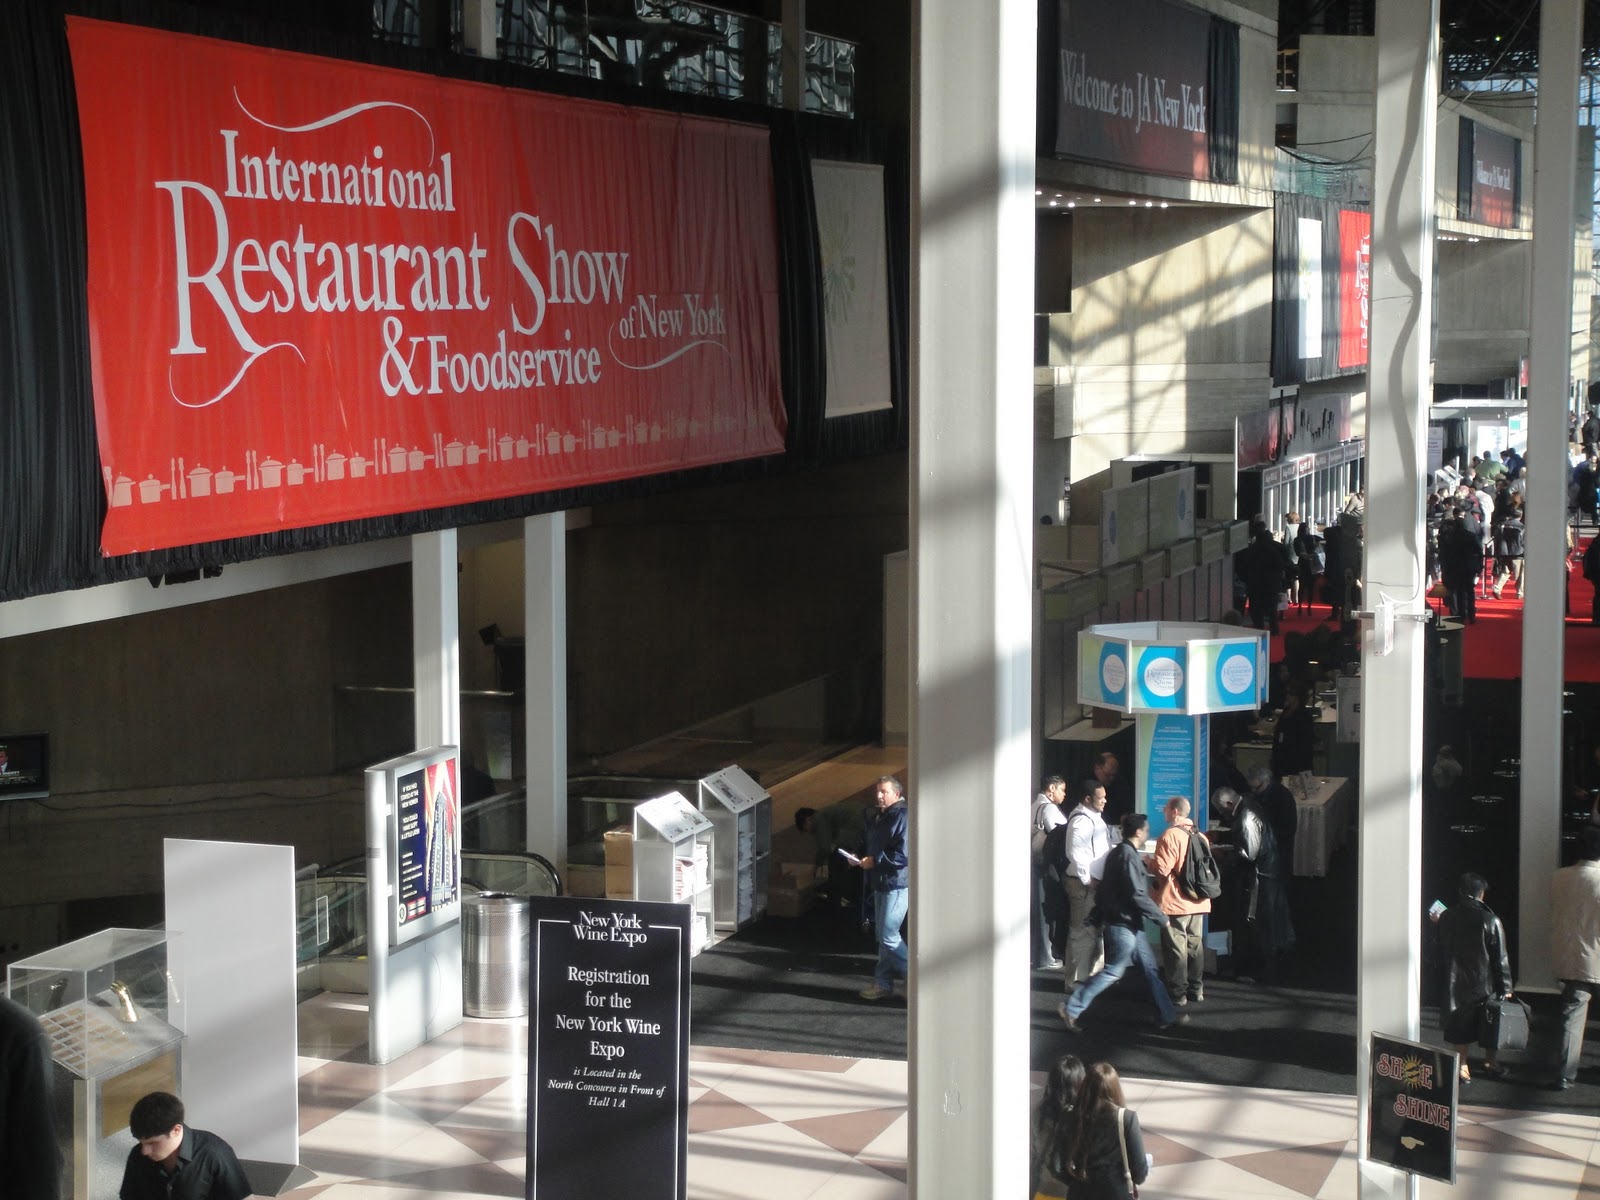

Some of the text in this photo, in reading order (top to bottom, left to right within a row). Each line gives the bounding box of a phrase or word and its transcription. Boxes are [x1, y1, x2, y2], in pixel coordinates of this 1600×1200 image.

[1060, 48, 1207, 134] Welcome to JA New York
[220, 129, 456, 212] International
[154, 181, 630, 355] Restaurant Show
[619, 293, 727, 340] of New York
[427, 329, 601, 394] Foodservice
[579, 911, 642, 929] New York
[573, 924, 648, 947] Wine Expo
[567, 966, 650, 986] Registration
[585, 990, 632, 1008] for the
[555, 1014, 661, 1035] New York Wine
[590, 1040, 625, 1060] Expo
[573, 1066, 642, 1080] is Located in the
[547, 1079, 667, 1098] North Concourse in Front of
[588, 1096, 610, 1107] Hall
[1393, 1093, 1450, 1131] SHINE
